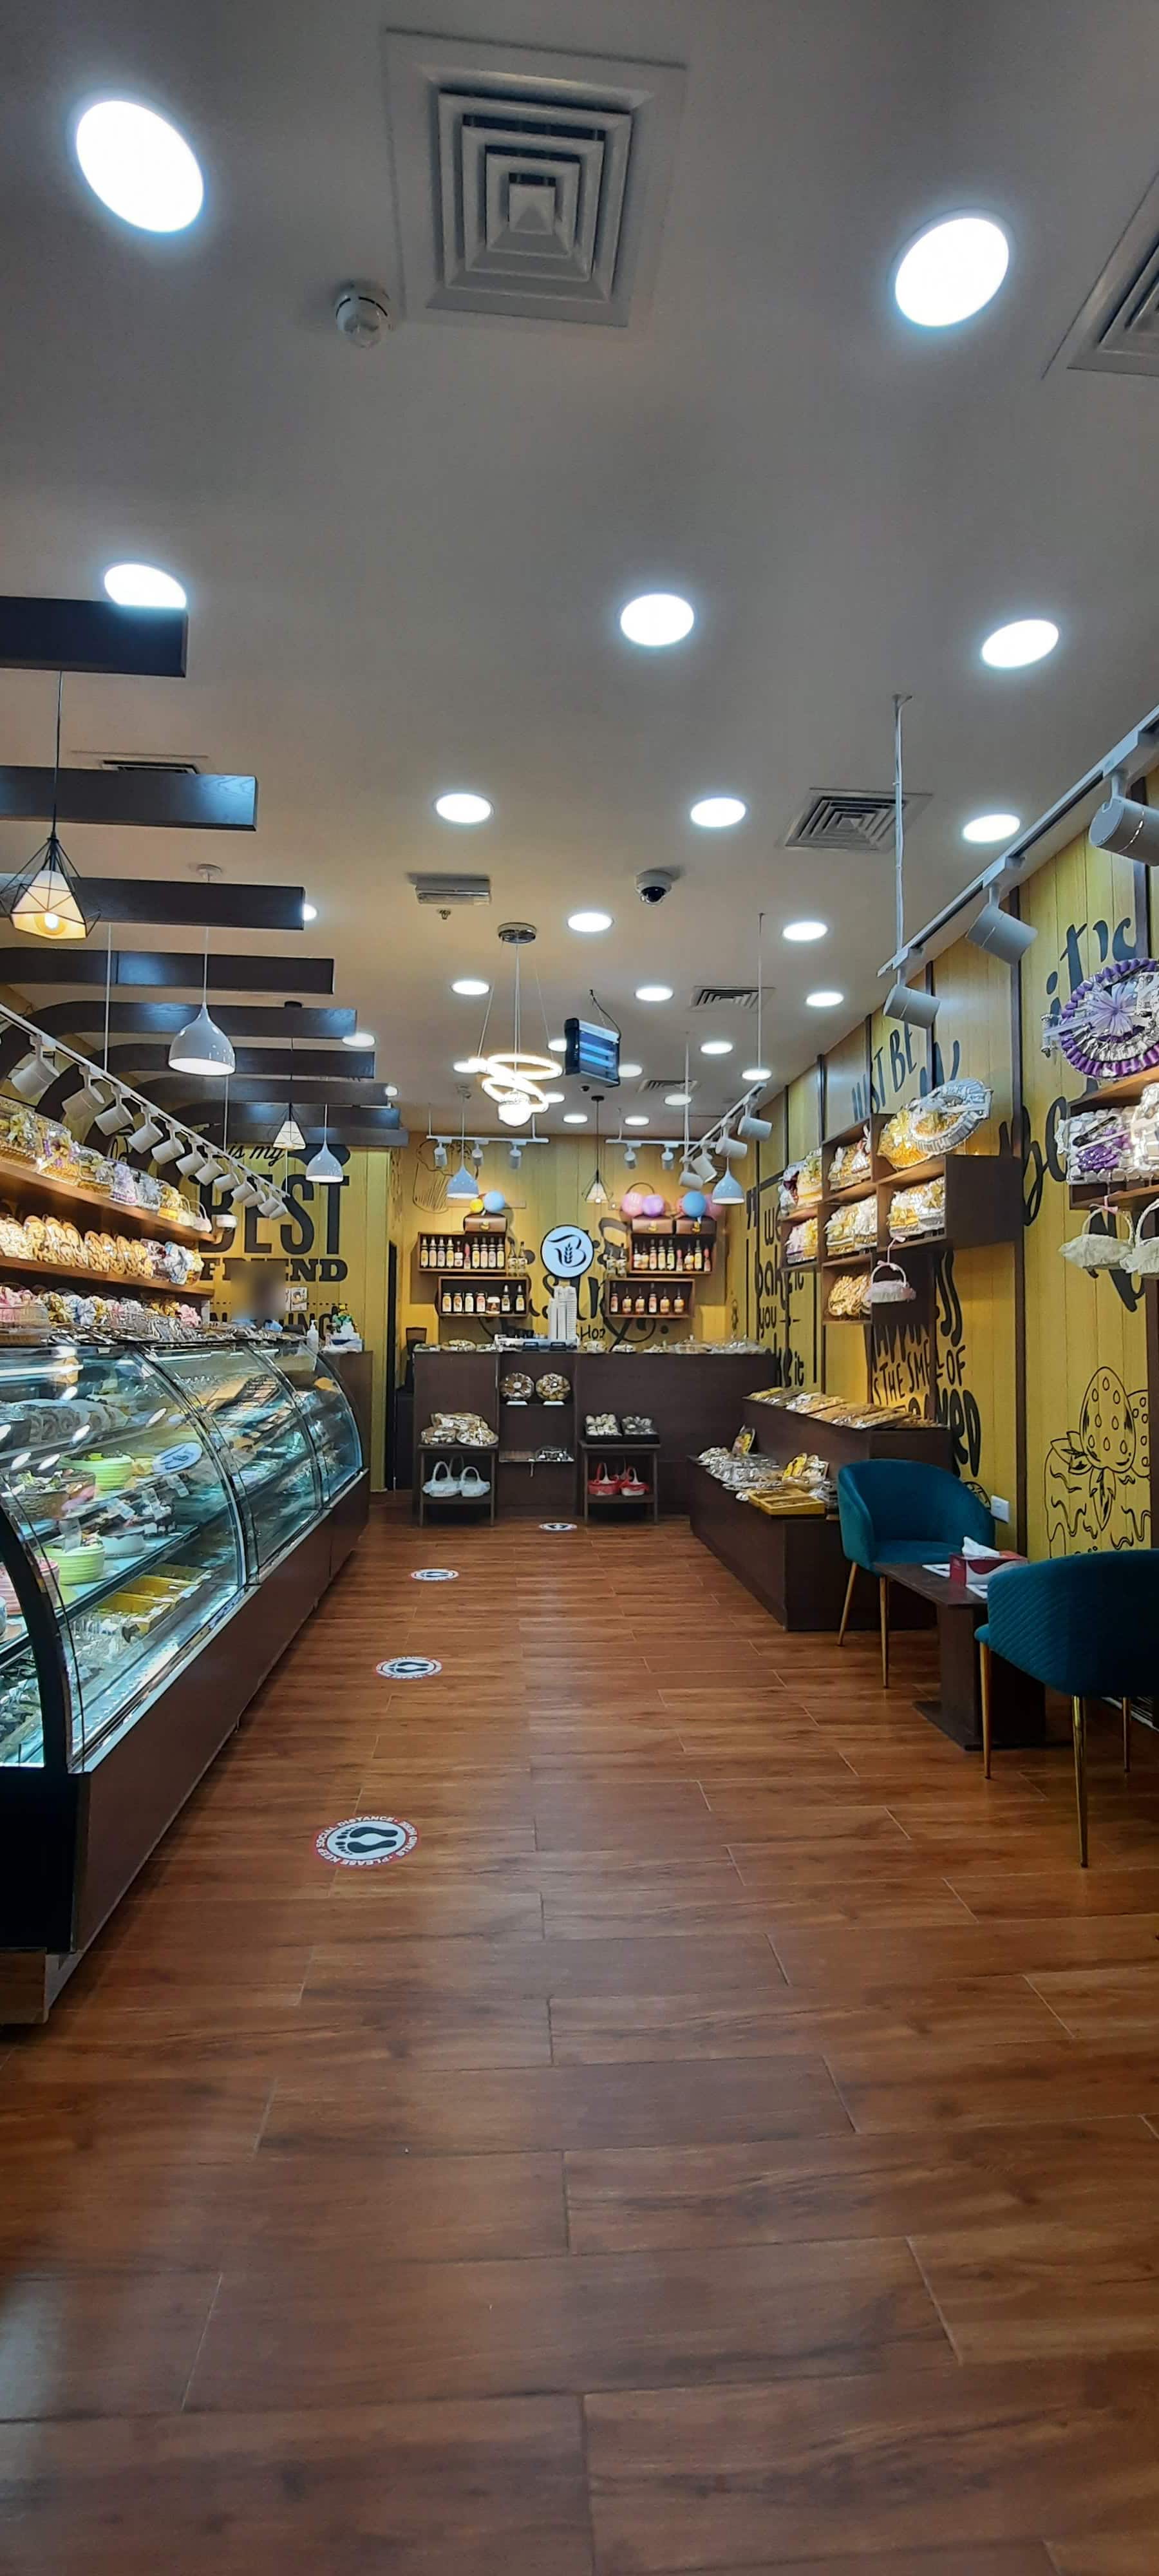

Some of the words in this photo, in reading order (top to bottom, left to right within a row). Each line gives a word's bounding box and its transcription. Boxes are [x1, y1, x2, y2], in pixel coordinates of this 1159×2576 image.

[227, 1144, 245, 1159] is
[249, 1144, 285, 1166] my
[187, 1173, 350, 1255] BEST
[759, 1305, 777, 1339] you
[795, 1350, 804, 1387] it
[880, 1361, 906, 1406] THE
[947, 1345, 966, 1386] OF
[337, 1815, 395, 1827] DISTANCE
[316, 1826, 338, 1848] SOCIAL
[317, 1848, 341, 1863] KEEP
[340, 1857, 390, 1865] PLEASE
